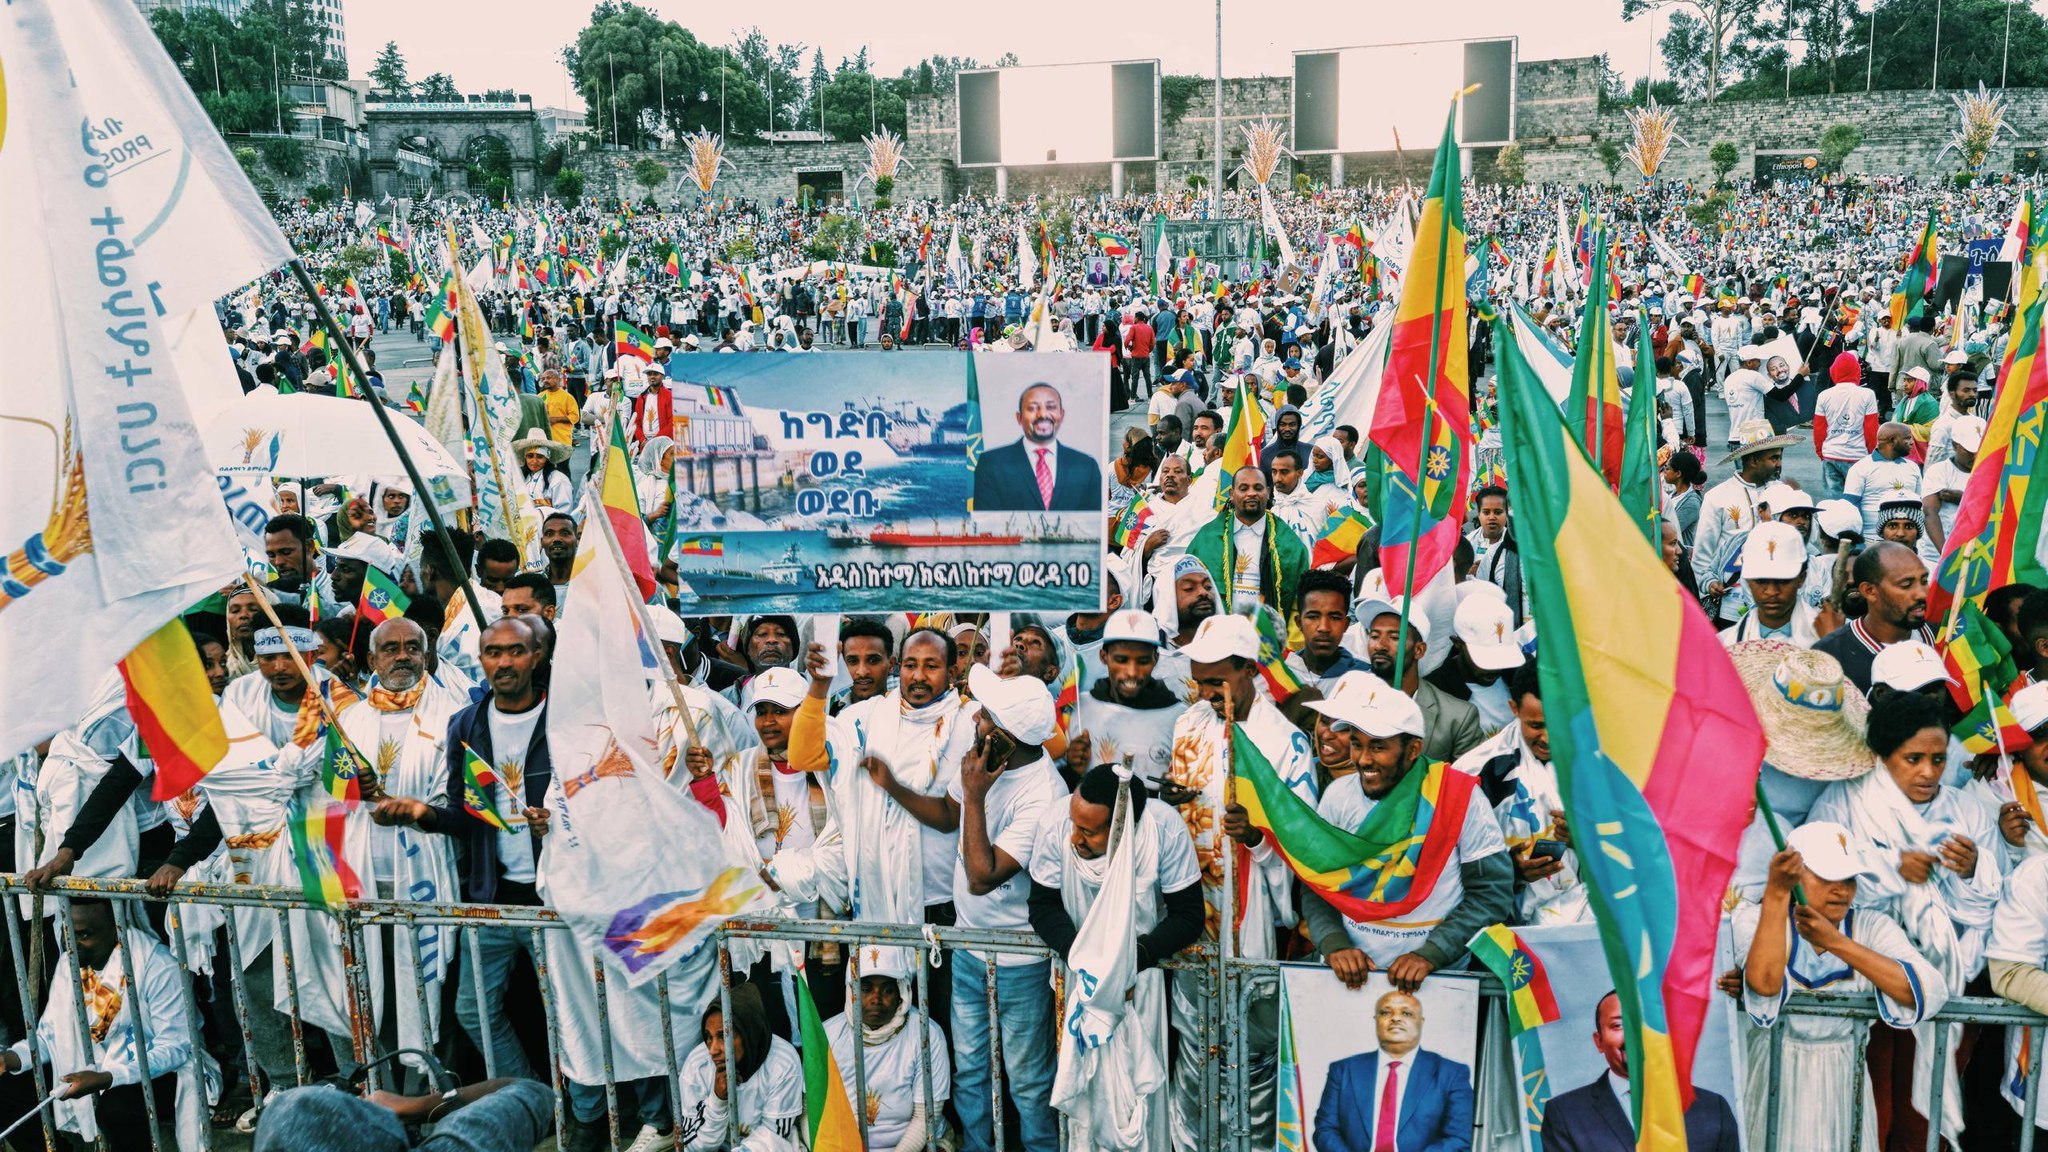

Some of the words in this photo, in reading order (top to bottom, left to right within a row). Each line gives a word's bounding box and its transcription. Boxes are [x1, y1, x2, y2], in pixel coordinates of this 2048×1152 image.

[779, 411, 892, 439] ከግድቡ
[811, 451, 865, 477] ወደ
[797, 490, 879, 516] ወደቡ
[816, 562, 860, 589] አዲስ
[866, 562, 914, 588] ከተማ
[918, 562, 960, 588] ክፍለ
[966, 562, 1012, 587] ከተማ
[1017, 562, 1061, 587] ወረዳ
[1067, 562, 1090, 586] 10
